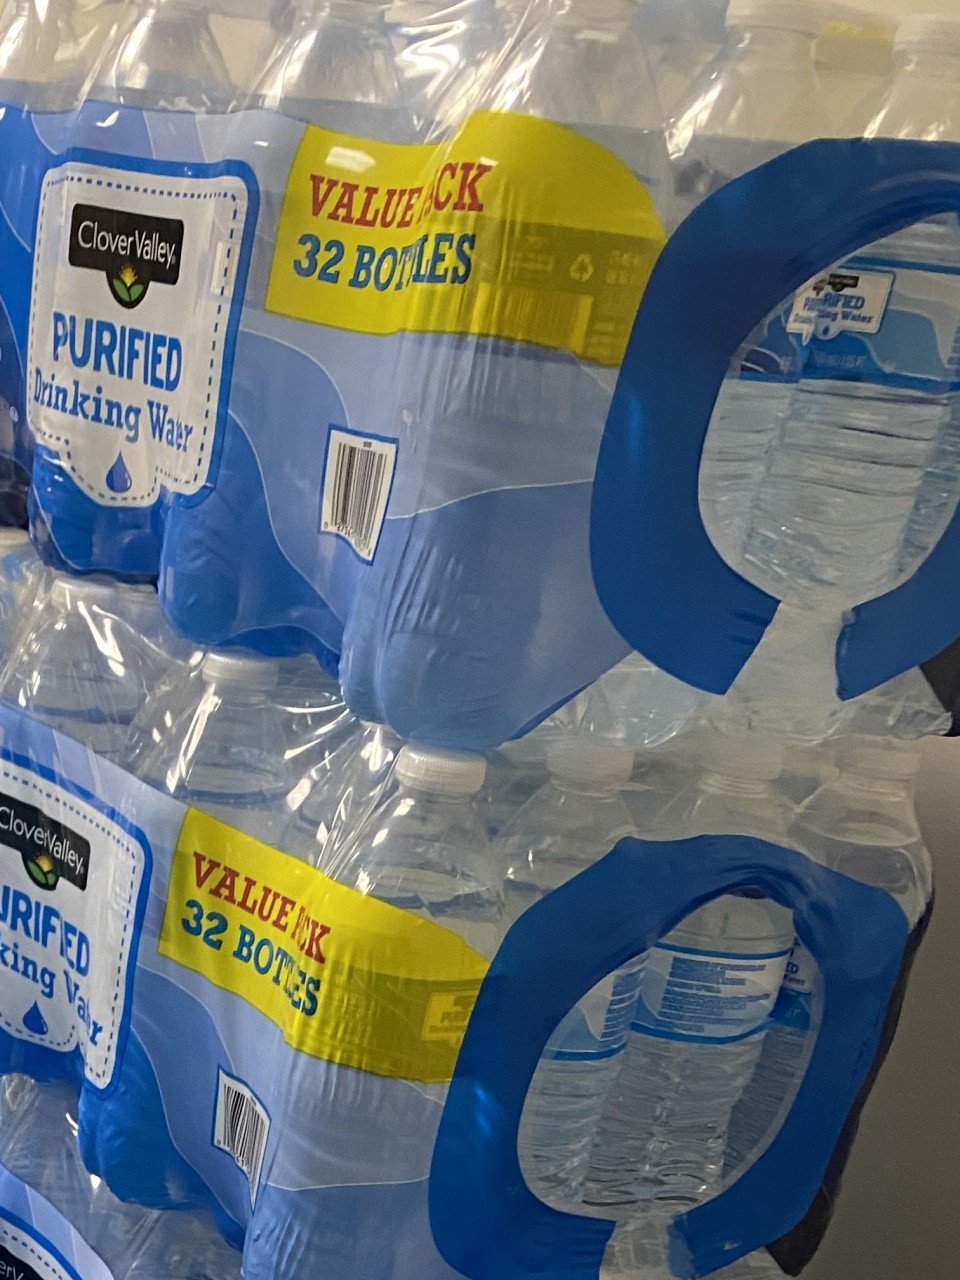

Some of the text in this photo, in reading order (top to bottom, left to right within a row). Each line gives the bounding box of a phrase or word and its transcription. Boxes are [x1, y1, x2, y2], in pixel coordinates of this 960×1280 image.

[310, 161, 493, 228] VALUE CK
[293, 233, 345, 283] 32
[348, 233, 476, 291] BOTLES
[53, 311, 182, 392] PURIFIED
[33, 367, 193, 453] Drinking Waer
[181, 899, 229, 952] 32
[192, 850, 296, 933] VALUE
